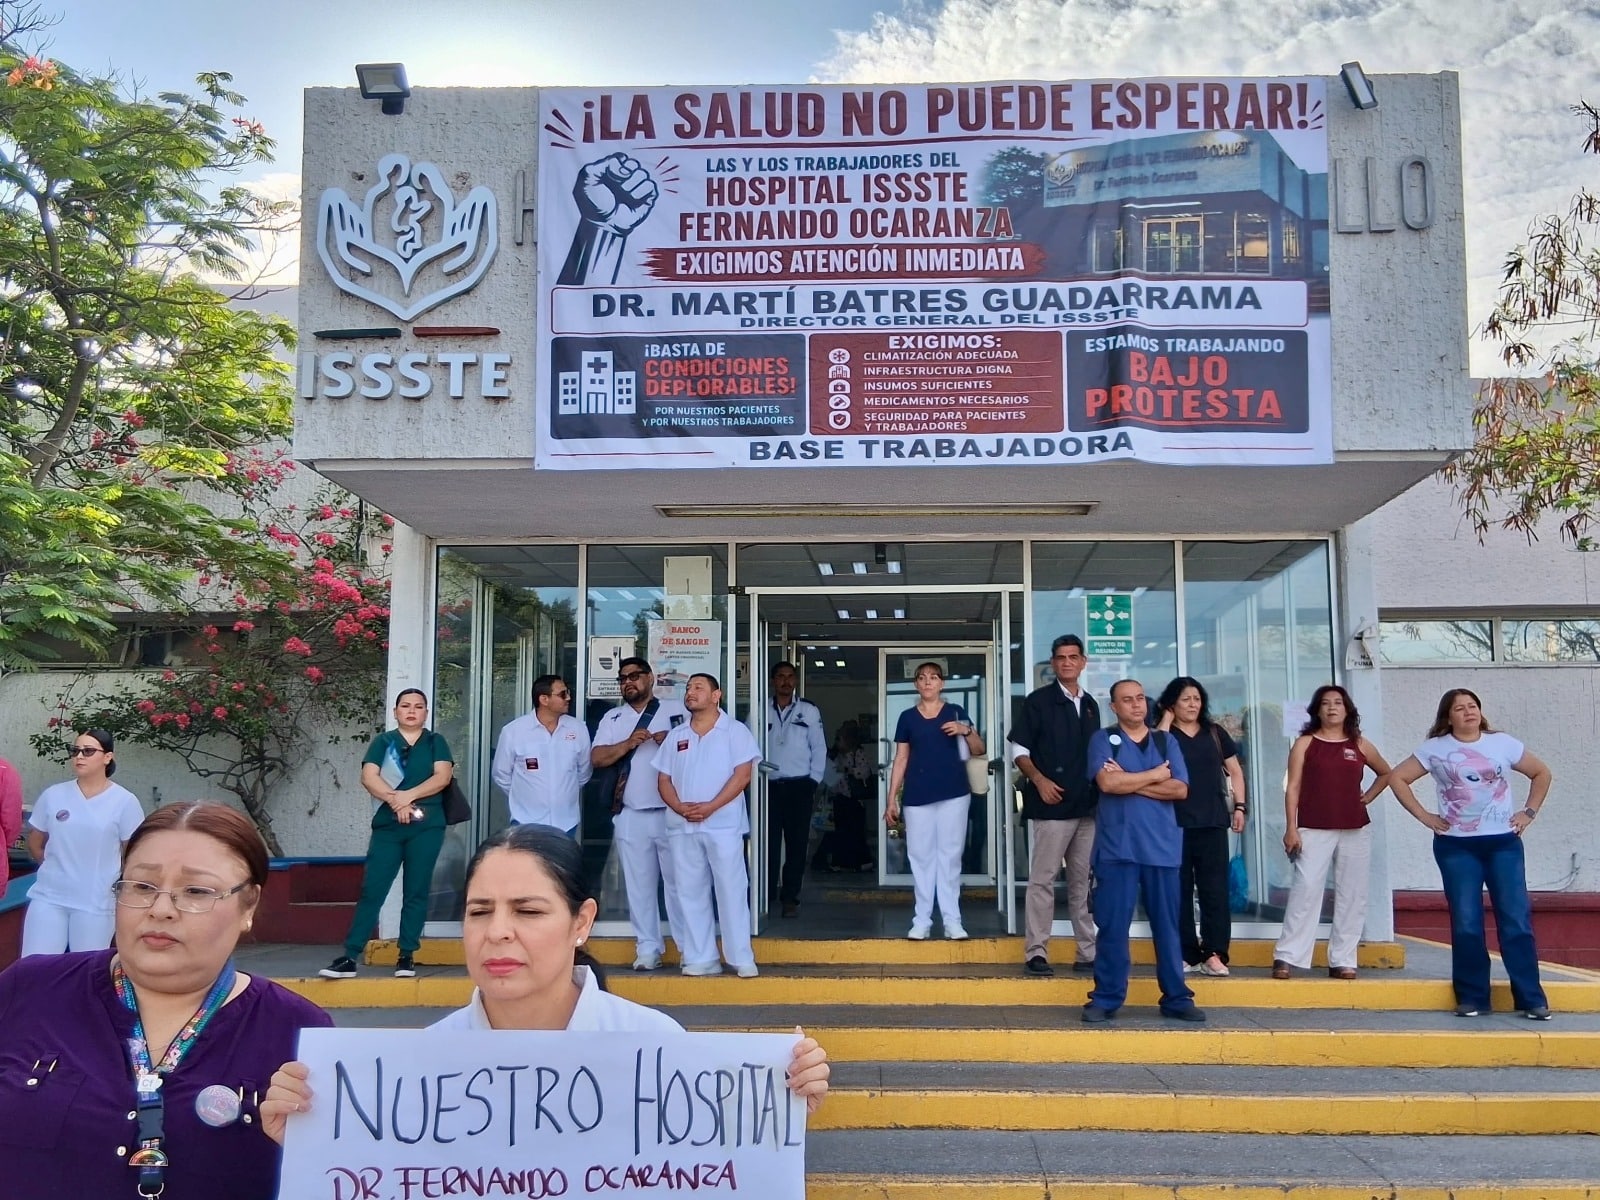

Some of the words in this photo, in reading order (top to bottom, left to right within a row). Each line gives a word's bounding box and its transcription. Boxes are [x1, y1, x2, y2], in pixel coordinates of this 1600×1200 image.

[582, 94, 656, 143] ¡LA
[673, 91, 825, 140] SALUD
[842, 90, 907, 137] NO
[927, 84, 1073, 133] PUEDE
[1091, 82, 1309, 131] ESPERAR!
[706, 157, 737, 173] LAS
[743, 157, 753, 172] Y
[758, 157, 788, 172] LOS
[795, 153, 922, 172] TRABAJADORES
[931, 152, 960, 168] DEL
[706, 175, 852, 206] HOSPITAL
[863, 172, 968, 203] ISSSTE
[1335, 155, 1435, 233] LLO
[515, 170, 538, 246] H
[679, 209, 838, 242] FERNANDO
[850, 207, 1014, 239] OCARANZA
[676, 250, 783, 275] EXIGIMOS
[790, 244, 897, 274] ATENCIÓN
[905, 247, 1025, 272] INMEDIATA
[592, 293, 655, 318] DR.
[671, 286, 796, 316] MARTÍ
[812, 288, 968, 314] BATRES
[982, 282, 1262, 312] GUADARRAMA
[740, 315, 867, 328] DIRECTOR
[875, 314, 992, 326] GENERAL
[1000, 313, 1046, 325] DEL
[1054, 308, 1139, 324] ISSSTE
[645, 342, 700, 358] ¡BASTA
[705, 342, 726, 356] DE
[889, 335, 1002, 349] EXIGIMOS:
[1085, 333, 1159, 353] ESTAMOS
[1164, 338, 1285, 353] TRABAJANDO
[863, 350, 953, 361] CLIMATIZACIÓN
[956, 350, 1019, 360] ADECUADA
[302, 351, 512, 400] ISSSTE
[645, 357, 789, 377] CONDICIONES
[863, 366, 972, 376] INFRAESTRUCTURA
[976, 365, 1013, 375] DIGNA
[1129, 351, 1228, 387] BAJO
[645, 376, 796, 397] DEPLORABLES!
[864, 381, 918, 390] INSUMOS
[921, 380, 993, 390] SUFICIENTES
[655, 406, 674, 416] POR
[676, 406, 726, 415] NUESTROS
[728, 405, 780, 415] PACIENTES
[864, 396, 956, 406] MEDICAMENTOS
[959, 395, 1029, 405] NECESARIOS
[1085, 384, 1282, 419] PROTESTA
[642, 418, 649, 427] Y
[650, 418, 669, 426] POR
[671, 417, 719, 426] NUESTROS
[722, 416, 794, 426] TRABAJADORES
[864, 412, 929, 421] SEGURIDAD
[933, 411, 964, 421] PARA
[966, 411, 1026, 420] PACIENTES
[864, 422, 871, 432] Y
[876, 421, 968, 432] TRABAJADORES
[750, 440, 844, 460] BASE
[859, 431, 1134, 459] TRABAJADORA
[671, 626, 701, 634] BANCO
[675, 638, 709, 646] SANGRE
[334, 1056, 604, 1147] NUESTRO
[634, 1046, 802, 1156] HOSPITAL
[393, 1166, 568, 1200] FERNANDO
[585, 1159, 737, 1193] OCARANZA
